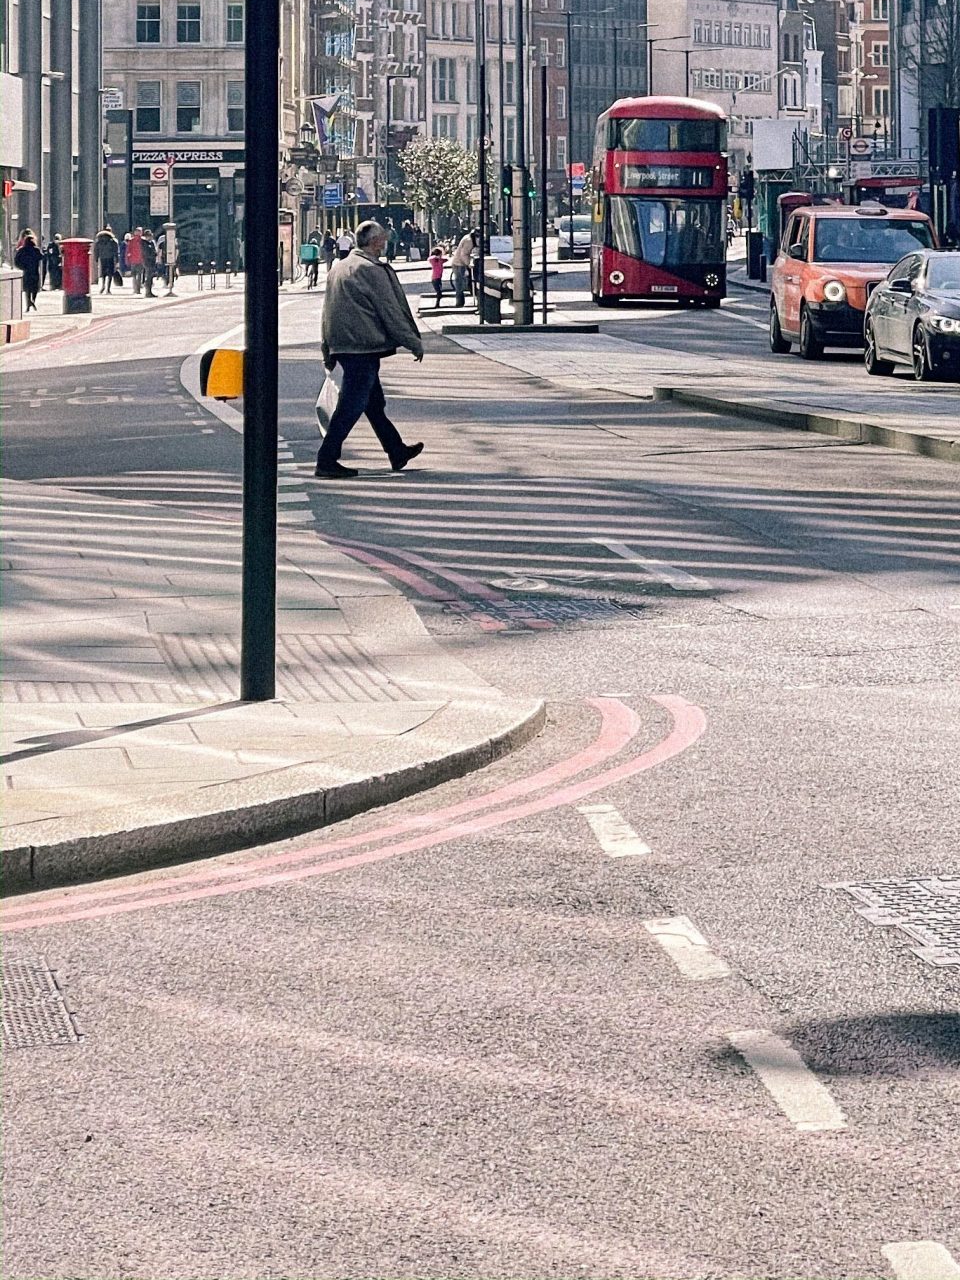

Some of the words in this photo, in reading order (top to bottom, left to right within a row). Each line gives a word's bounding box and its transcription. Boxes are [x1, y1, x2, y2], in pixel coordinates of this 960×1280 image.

[842, 128, 851, 137] G
[132, 151, 223, 161] PIZZAEXPRESS
[626, 171, 657, 182] Liverpool
[658, 171, 679, 181] Street
[692, 171, 702, 185] 11
